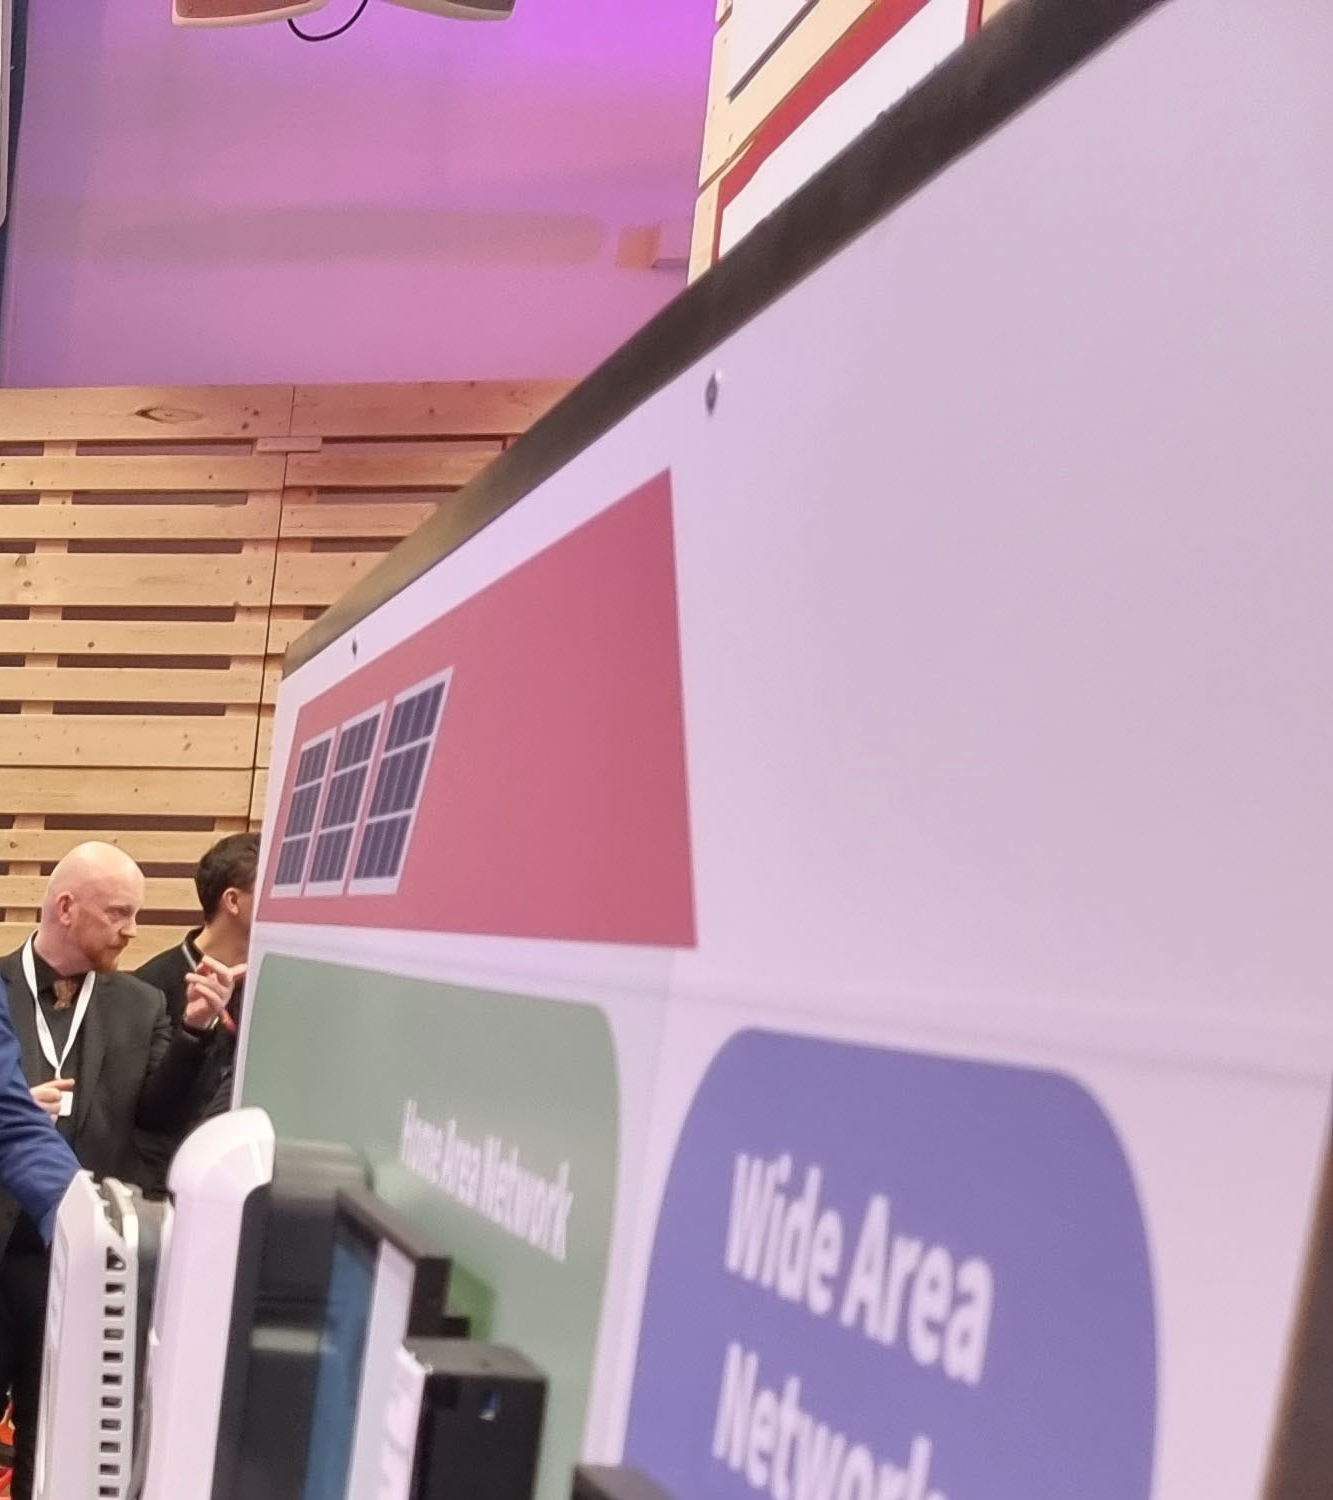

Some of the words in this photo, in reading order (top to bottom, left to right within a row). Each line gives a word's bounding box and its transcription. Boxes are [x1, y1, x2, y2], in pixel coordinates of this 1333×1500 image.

[401, 1098, 443, 1184] Home
[440, 1117, 482, 1208] Area
[478, 1133, 574, 1264] Network
[724, 1152, 844, 1316] Wide
[839, 1194, 995, 1386] Area
